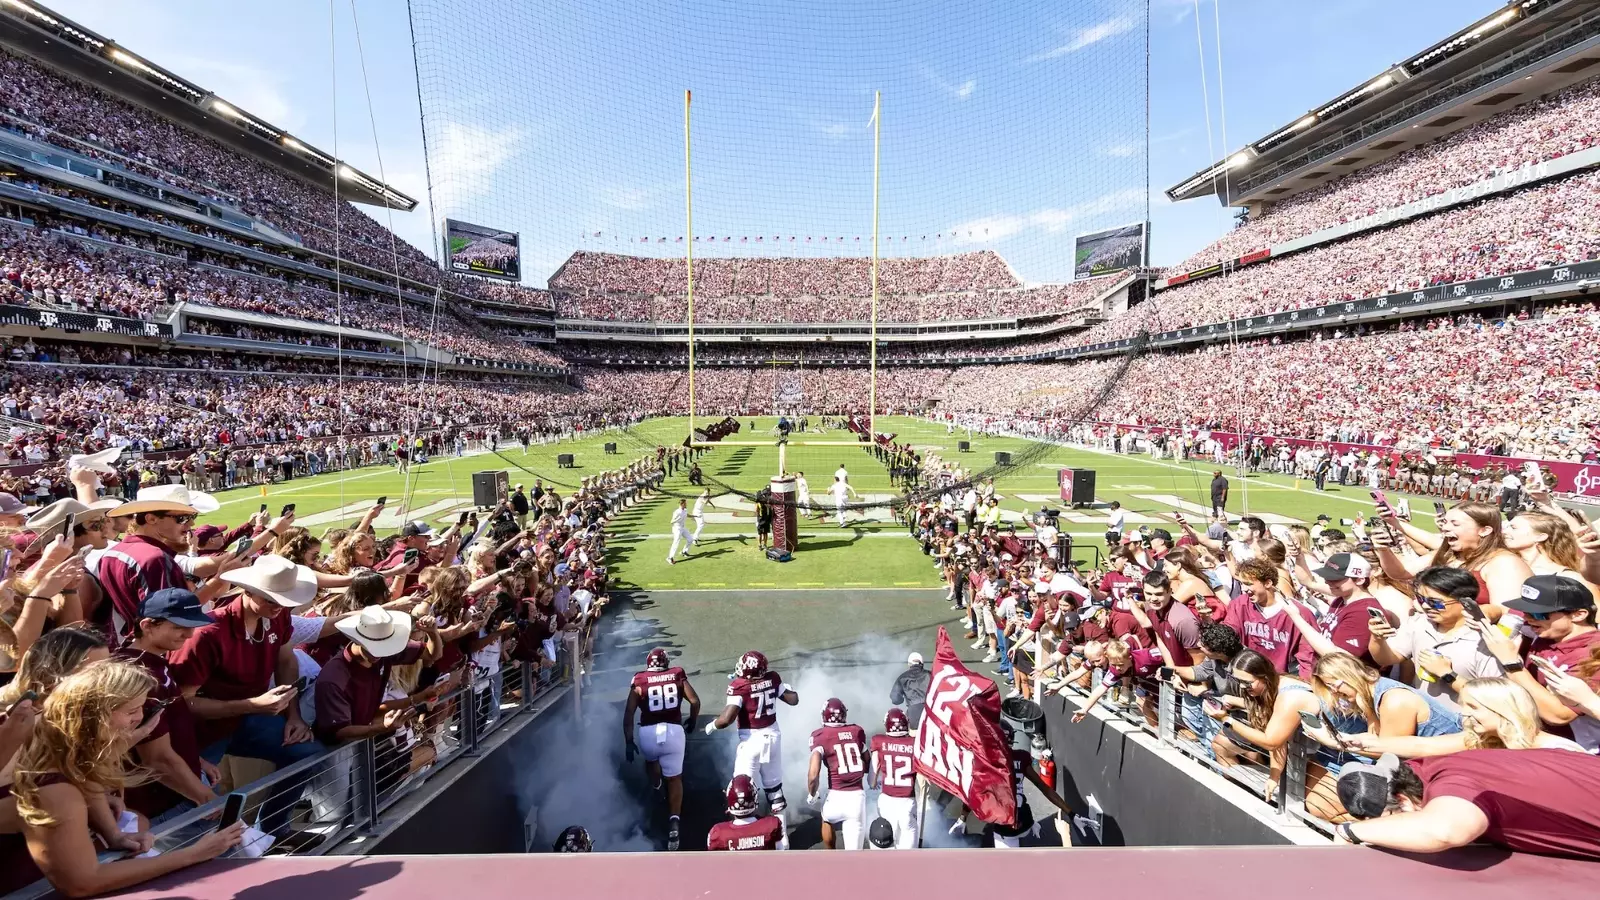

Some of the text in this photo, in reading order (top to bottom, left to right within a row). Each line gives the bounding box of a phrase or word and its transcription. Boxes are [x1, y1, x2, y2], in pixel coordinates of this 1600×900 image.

[1505, 163, 1548, 187] MAN
[648, 683, 678, 711] 88
[750, 689, 776, 719] 75
[838, 732, 853, 740] DIGGS
[888, 744, 914, 754] MATHEWS
[833, 743, 864, 774] 10
[884, 754, 912, 787] 12
[728, 835, 765, 851] C. JOHNSON
